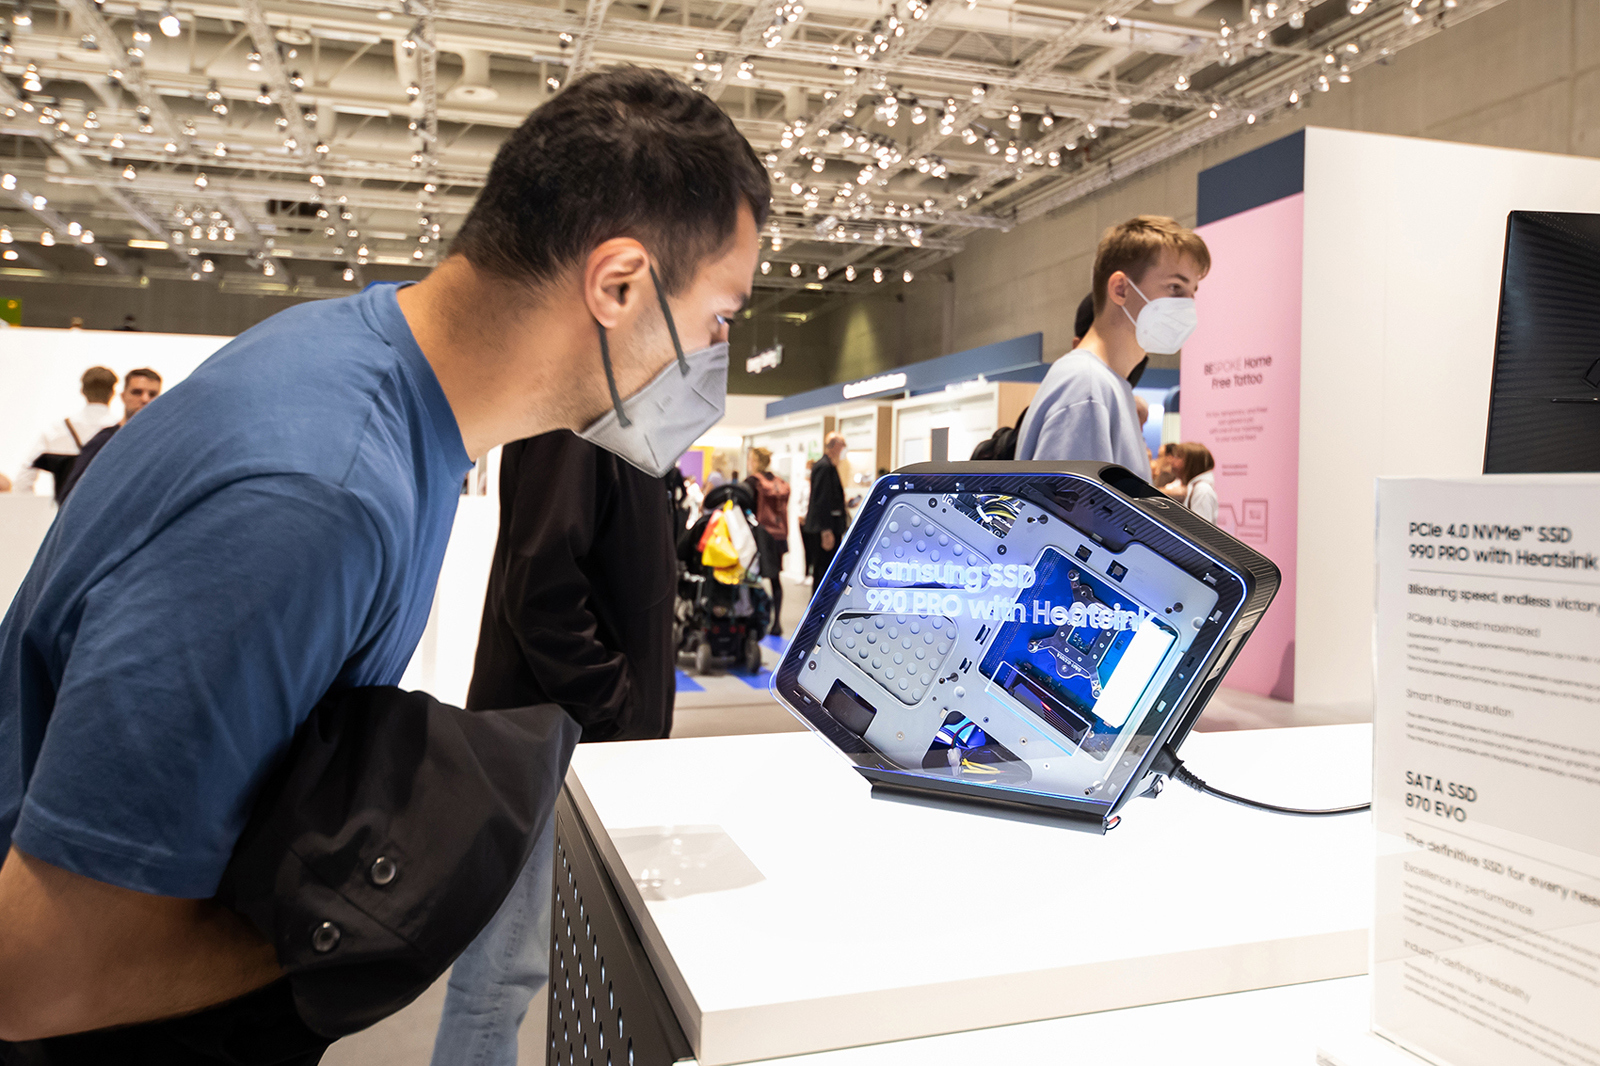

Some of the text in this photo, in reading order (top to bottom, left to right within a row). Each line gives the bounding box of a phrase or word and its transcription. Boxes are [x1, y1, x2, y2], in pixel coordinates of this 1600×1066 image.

[1244, 355, 1272, 369] Home
[1211, 373, 1263, 390] Free Tattoo
[1409, 522, 1442, 537] PCIe
[1447, 524, 1469, 539] 4.0
[1538, 526, 1573, 543] SSD
[1408, 544, 1600, 570] 990 PRO with Heatsink
[866, 557, 1037, 592] Samsung SSD
[1408, 583, 1457, 602] Blistering
[1502, 593, 1551, 608] endless
[866, 589, 1158, 633] 990 PRO with Heatsink
[1405, 770, 1478, 803] SATA SSD
[1405, 792, 1467, 822] 870 EVO
[1404, 832, 1425, 847] The
[1427, 841, 1479, 867] definitive
[1481, 857, 1505, 875] SSD
[1507, 866, 1525, 881] for
[1528, 875, 1570, 899] every
